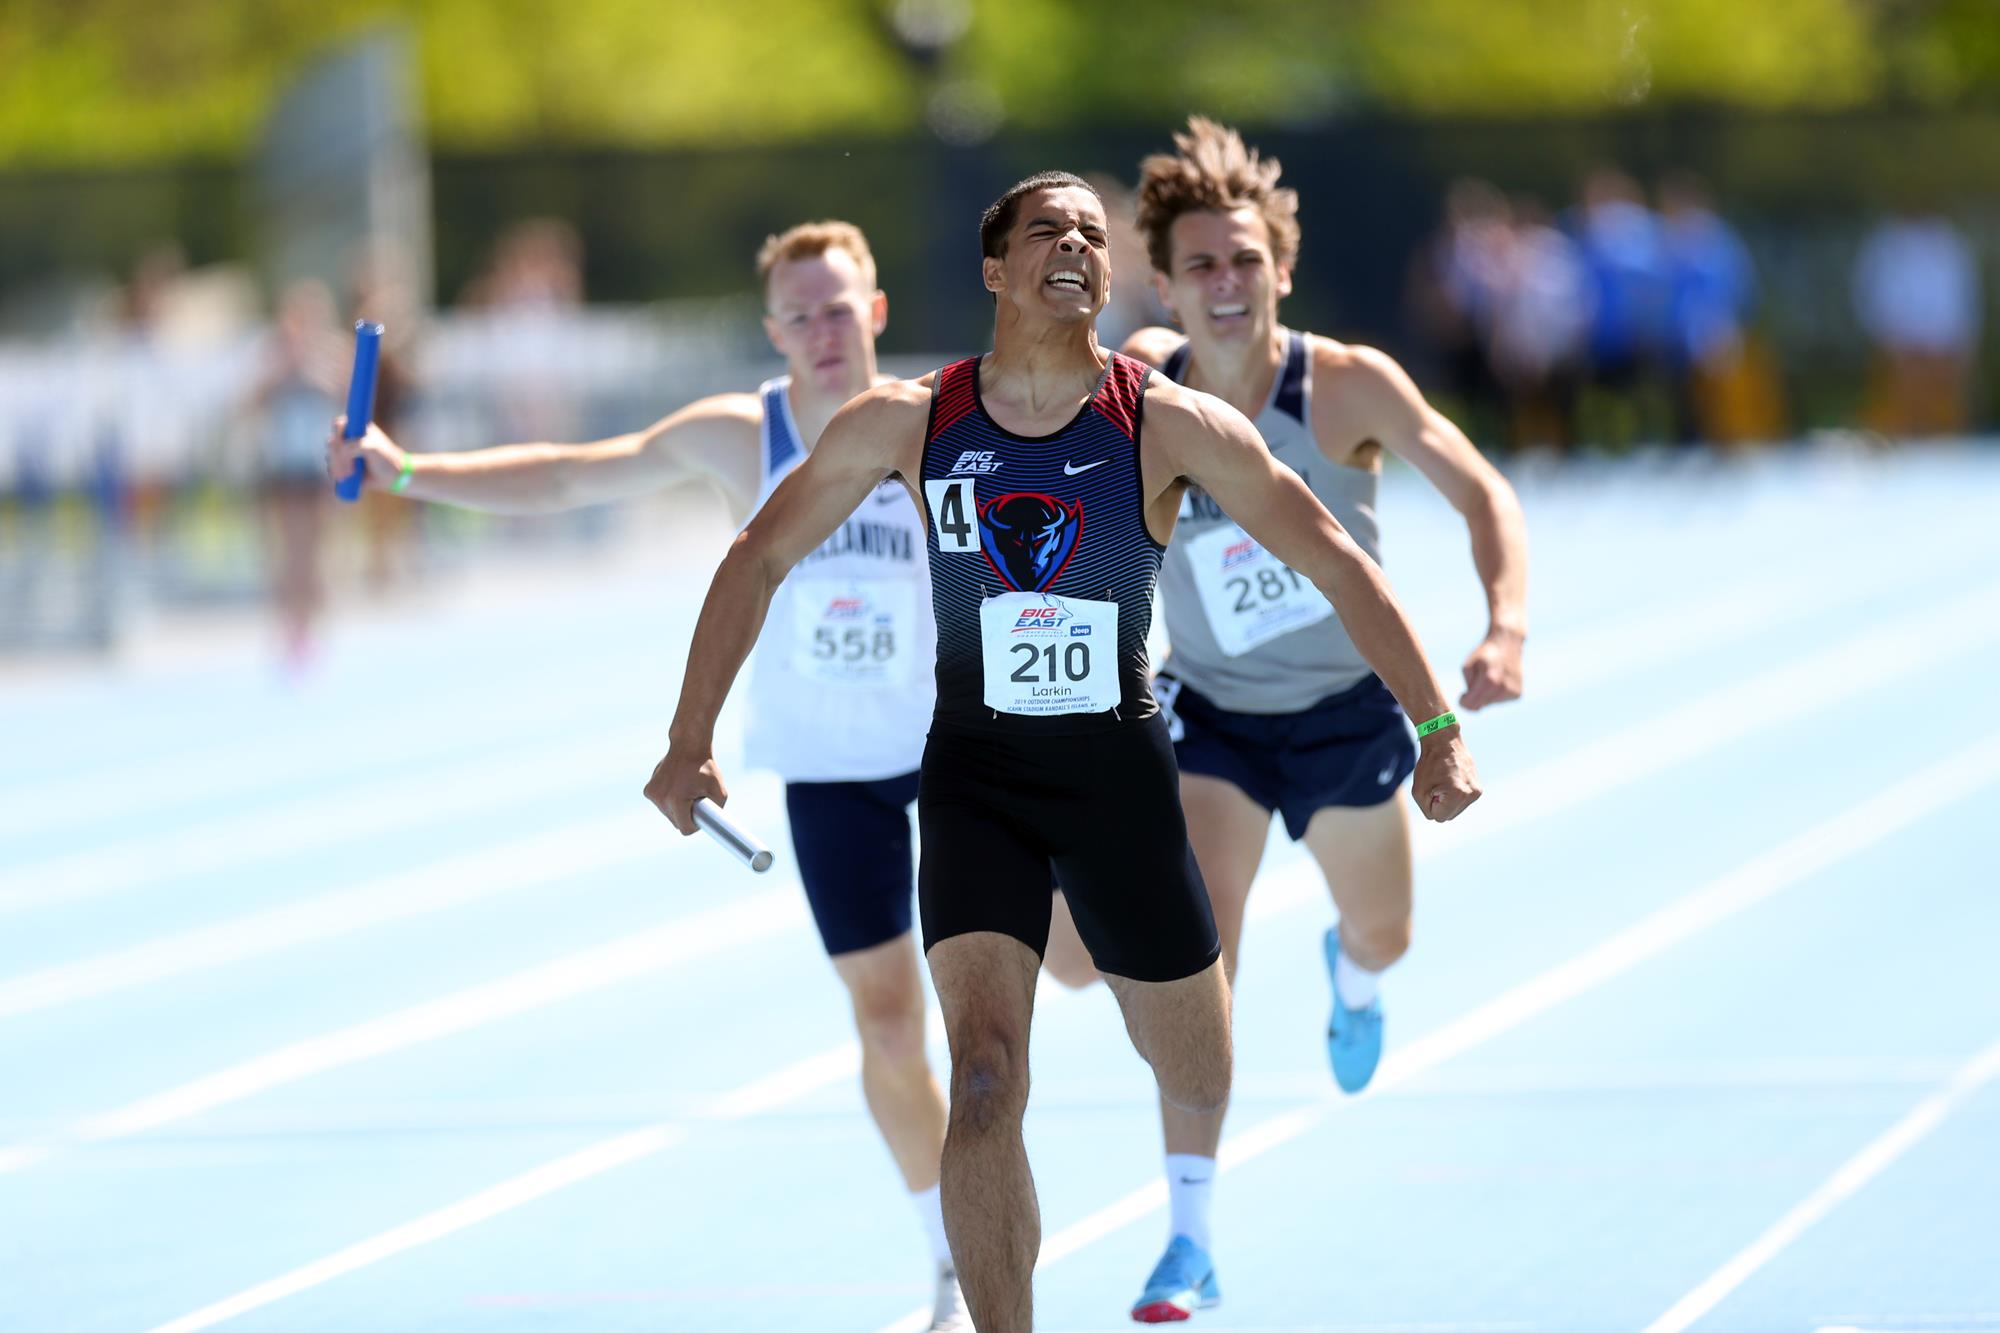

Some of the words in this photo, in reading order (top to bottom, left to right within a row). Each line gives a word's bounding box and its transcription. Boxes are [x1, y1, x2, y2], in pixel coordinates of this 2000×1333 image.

[958, 451, 995, 461] BIG
[951, 462, 1003, 472] EAST
[941, 483, 972, 547] 4
[1225, 565, 1301, 614] 281
[1020, 608, 1058, 618] BIG
[1014, 618, 1068, 627] EAST
[813, 625, 896, 662] 558
[1010, 642, 1090, 682] 210
[1032, 686, 1072, 696] Larkin
[1051, 696, 1090, 705] CHAMPIONSHIPS
